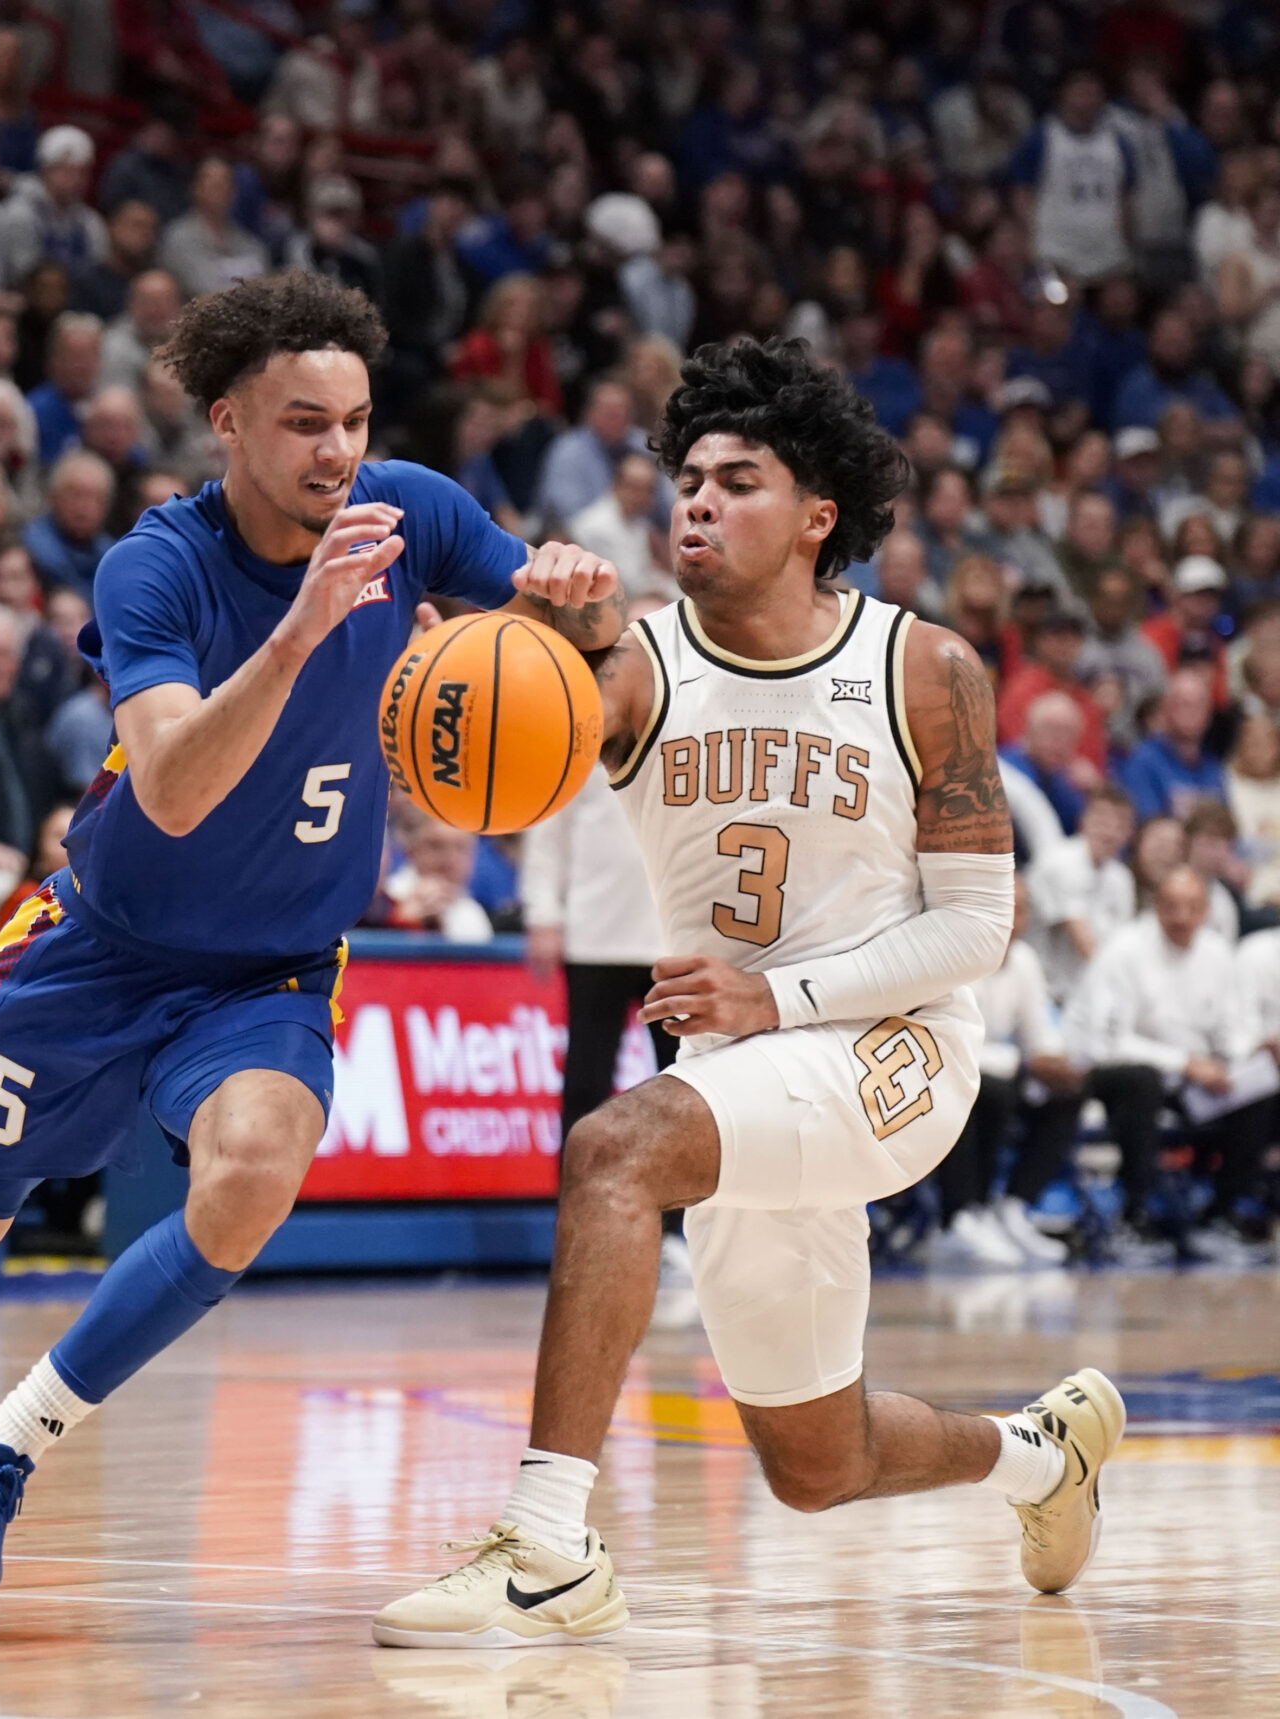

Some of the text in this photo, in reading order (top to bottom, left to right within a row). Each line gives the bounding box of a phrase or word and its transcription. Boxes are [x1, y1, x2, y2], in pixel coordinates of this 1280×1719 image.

[381, 652, 426, 795] Wilson
[431, 682, 469, 789] NCAA
[831, 678, 872, 704] XII
[293, 762, 352, 844] 5
[660, 727, 870, 821] BUFFS
[711, 821, 791, 948] 3
[404, 1003, 569, 1096] Merit
[422, 1106, 532, 1157] CREDIT
